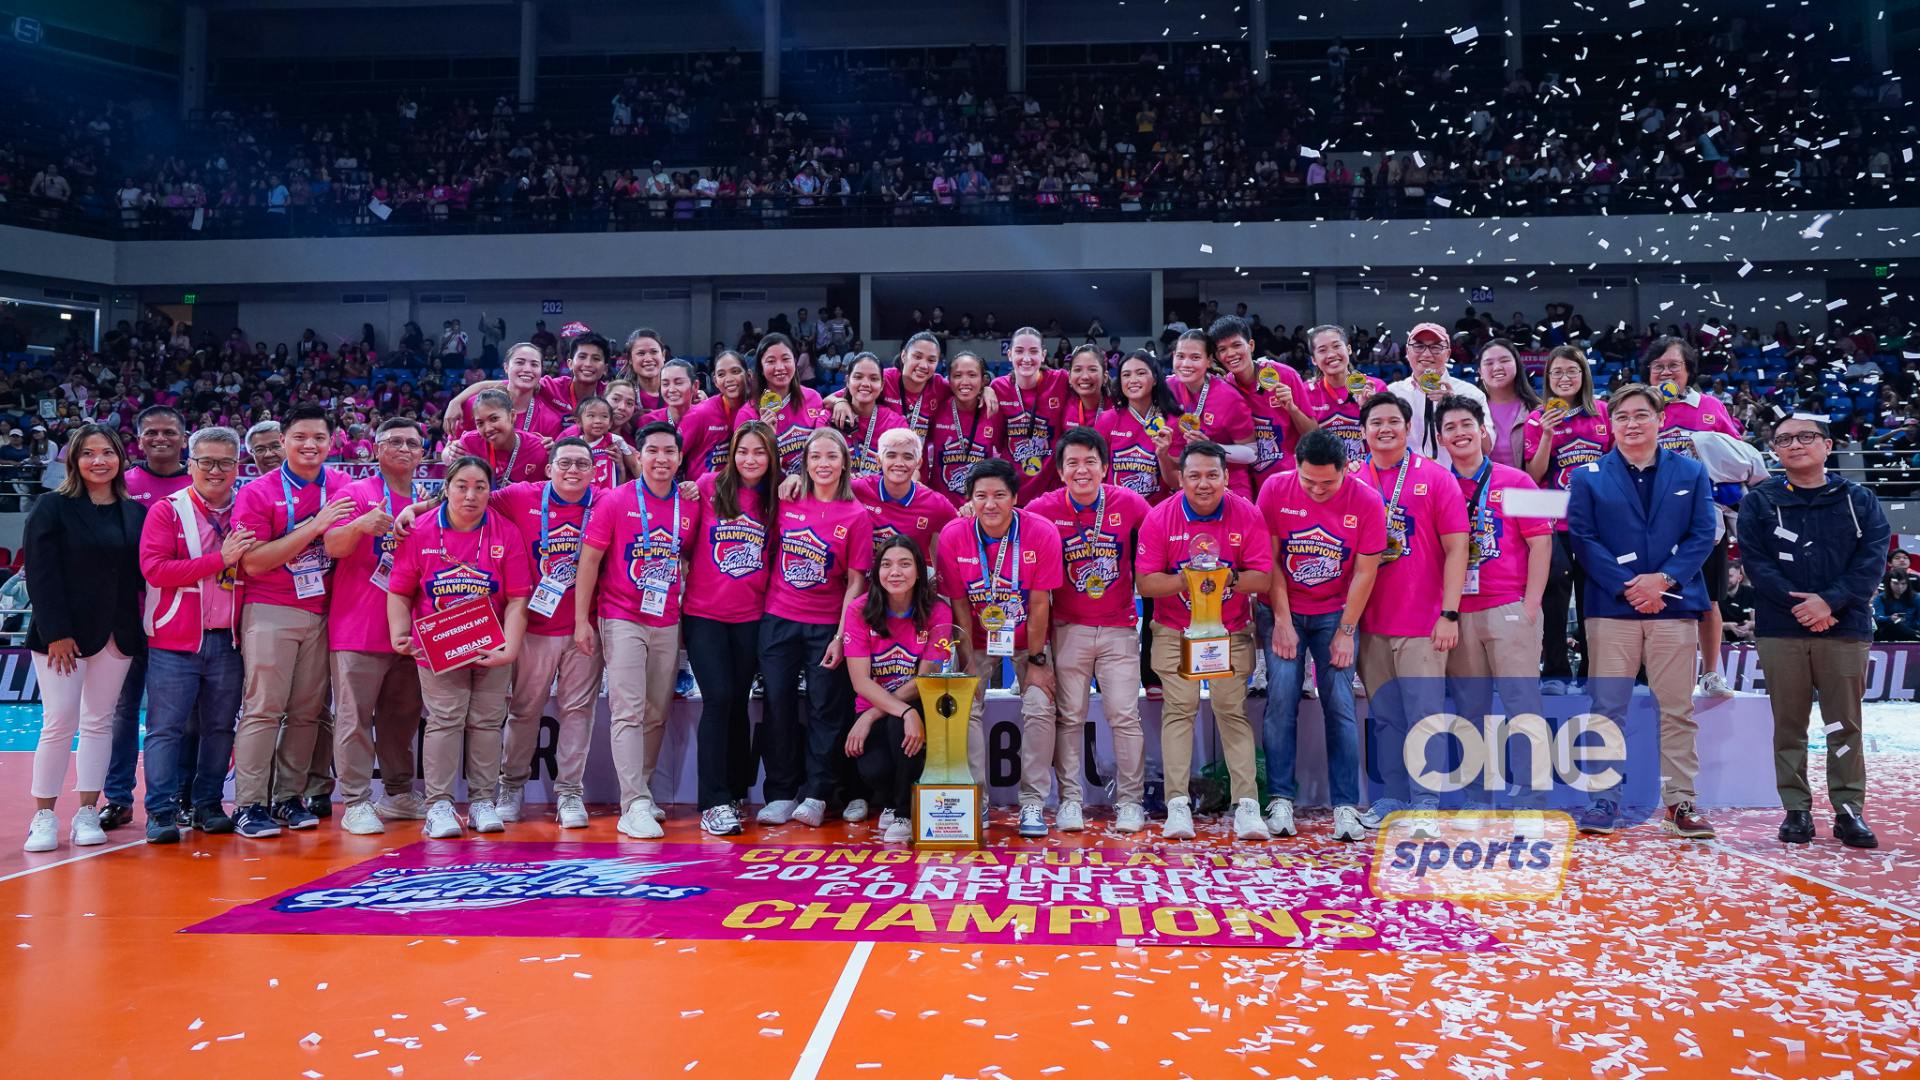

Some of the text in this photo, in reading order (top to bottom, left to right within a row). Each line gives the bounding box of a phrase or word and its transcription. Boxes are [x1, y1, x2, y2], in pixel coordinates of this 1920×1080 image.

[1472, 289, 1493, 302] 204
[543, 301, 562, 313] 202
[1112, 462, 1157, 474] CHAMPIONS
[1280, 507, 1299, 515] Allianz
[714, 531, 765, 546] CHAMPIONS
[1315, 540, 1343, 552] CONFERENCE
[782, 543, 827, 565] CHAMPIONS
[1286, 544, 1343, 561] CHAMPIONS
[720, 556, 764, 573] Smashers
[433, 578, 490, 587] REINFORCED CONFERENCE
[784, 568, 829, 584] Smashers
[1292, 567, 1343, 582] Smashers
[432, 584, 491, 596] CHAMPIONS
[432, 621, 475, 642] CONFERENCE
[474, 615, 490, 627] MVP
[444, 635, 493, 660] FABRIANO
[734, 864, 1345, 888] 2024 REINFORCED
[286, 880, 700, 908] Smashers
[814, 881, 1307, 904] CONFERENCE
[721, 899, 1377, 938] CHAMPIONS
